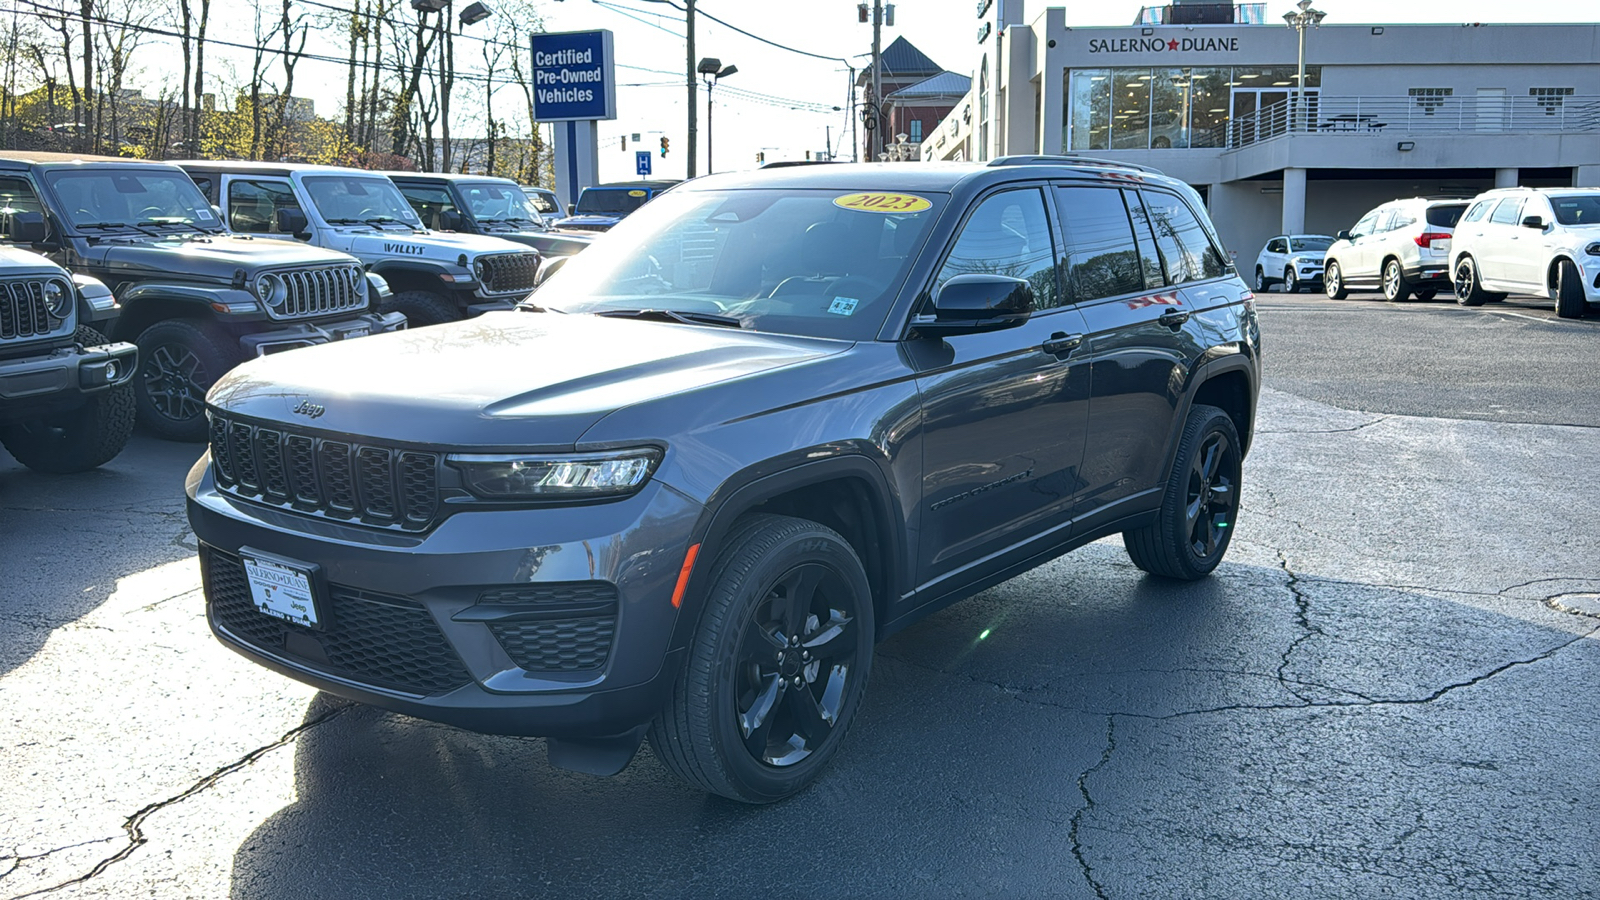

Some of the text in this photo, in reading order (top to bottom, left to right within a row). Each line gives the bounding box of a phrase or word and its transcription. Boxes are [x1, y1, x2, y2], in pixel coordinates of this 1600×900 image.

[1088, 37, 1239, 53] SALERNO DUANE
[535, 48, 592, 66] Certified
[537, 67, 602, 85] Pre-Owned
[538, 87, 593, 104] Vehicles
[639, 156, 648, 168] H
[845, 195, 918, 209] 2023
[384, 243, 426, 255] WILLYS
[293, 399, 325, 419] Jeep
[247, 565, 280, 582] SALERNO
[282, 575, 309, 590] DUANE
[290, 601, 307, 613] Jeep
[259, 606, 312, 628] SALERNO DUANE
